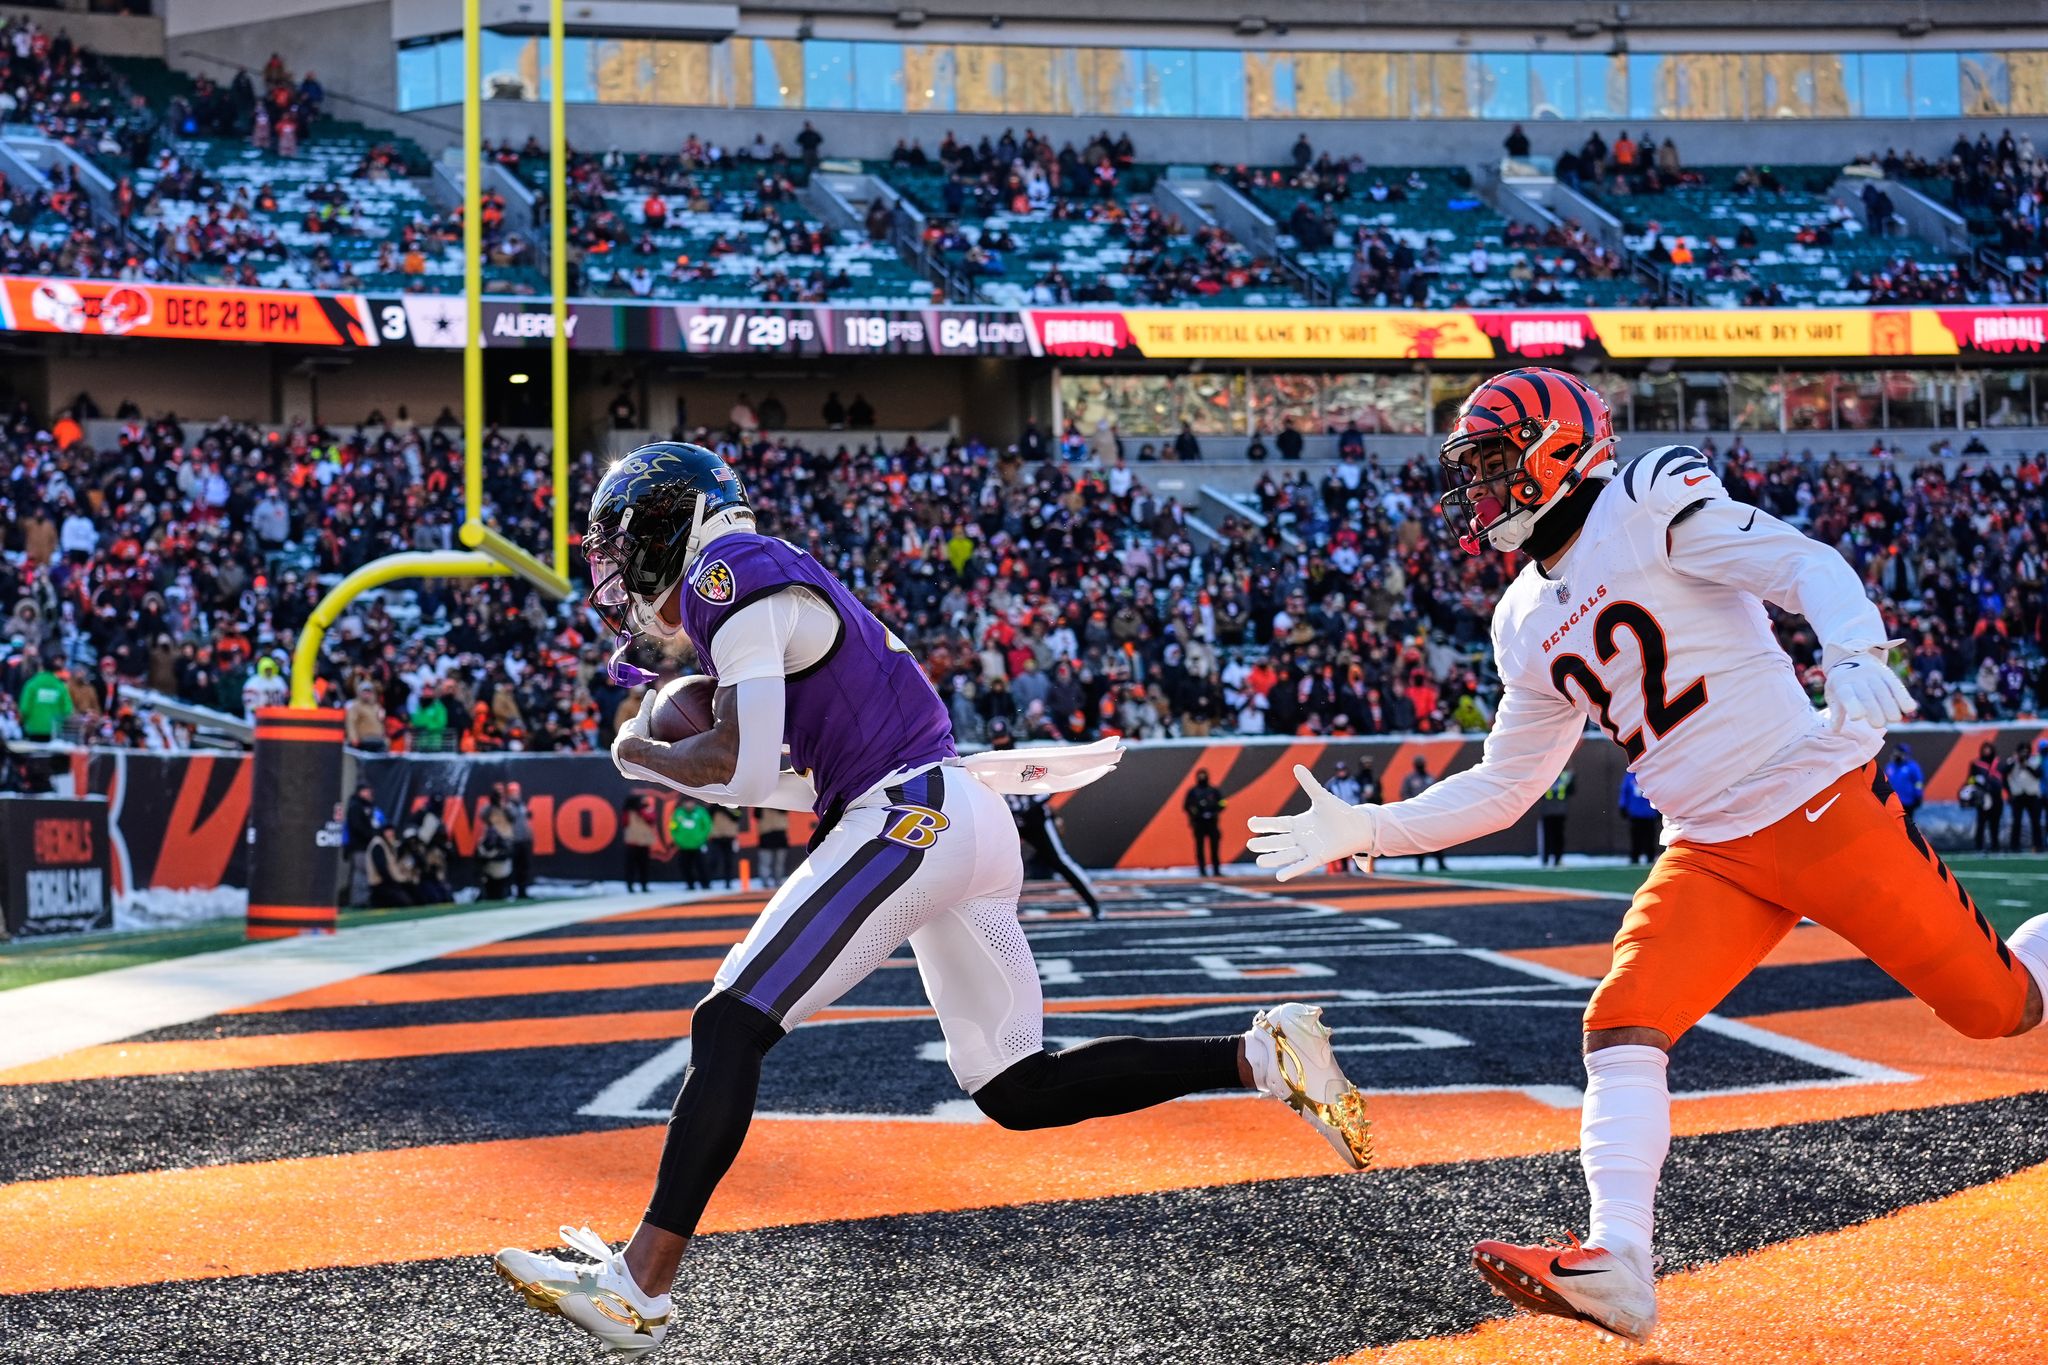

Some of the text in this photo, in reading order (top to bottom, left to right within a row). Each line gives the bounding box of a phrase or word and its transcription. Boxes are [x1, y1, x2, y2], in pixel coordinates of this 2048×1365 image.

[166, 298, 299, 332] DEC 28 1PM
[381, 305, 578, 340] 3 AUBRY
[844, 317, 1025, 348] 119 PTS 64 LONG
[1149, 325, 1174, 343] THE
[1183, 325, 1249, 343] OFFICIAL
[1255, 325, 1296, 343] GAME
[1339, 325, 1377, 343] SHOT
[1620, 324, 1645, 341] THE
[1654, 324, 1717, 341] OFFICIAL
[1724, 324, 1762, 341] GAME
[1806, 324, 1843, 341] SHOT
[1541, 584, 1608, 653] BENGALS
[1549, 599, 1709, 766] 22
[877, 804, 951, 850] B
